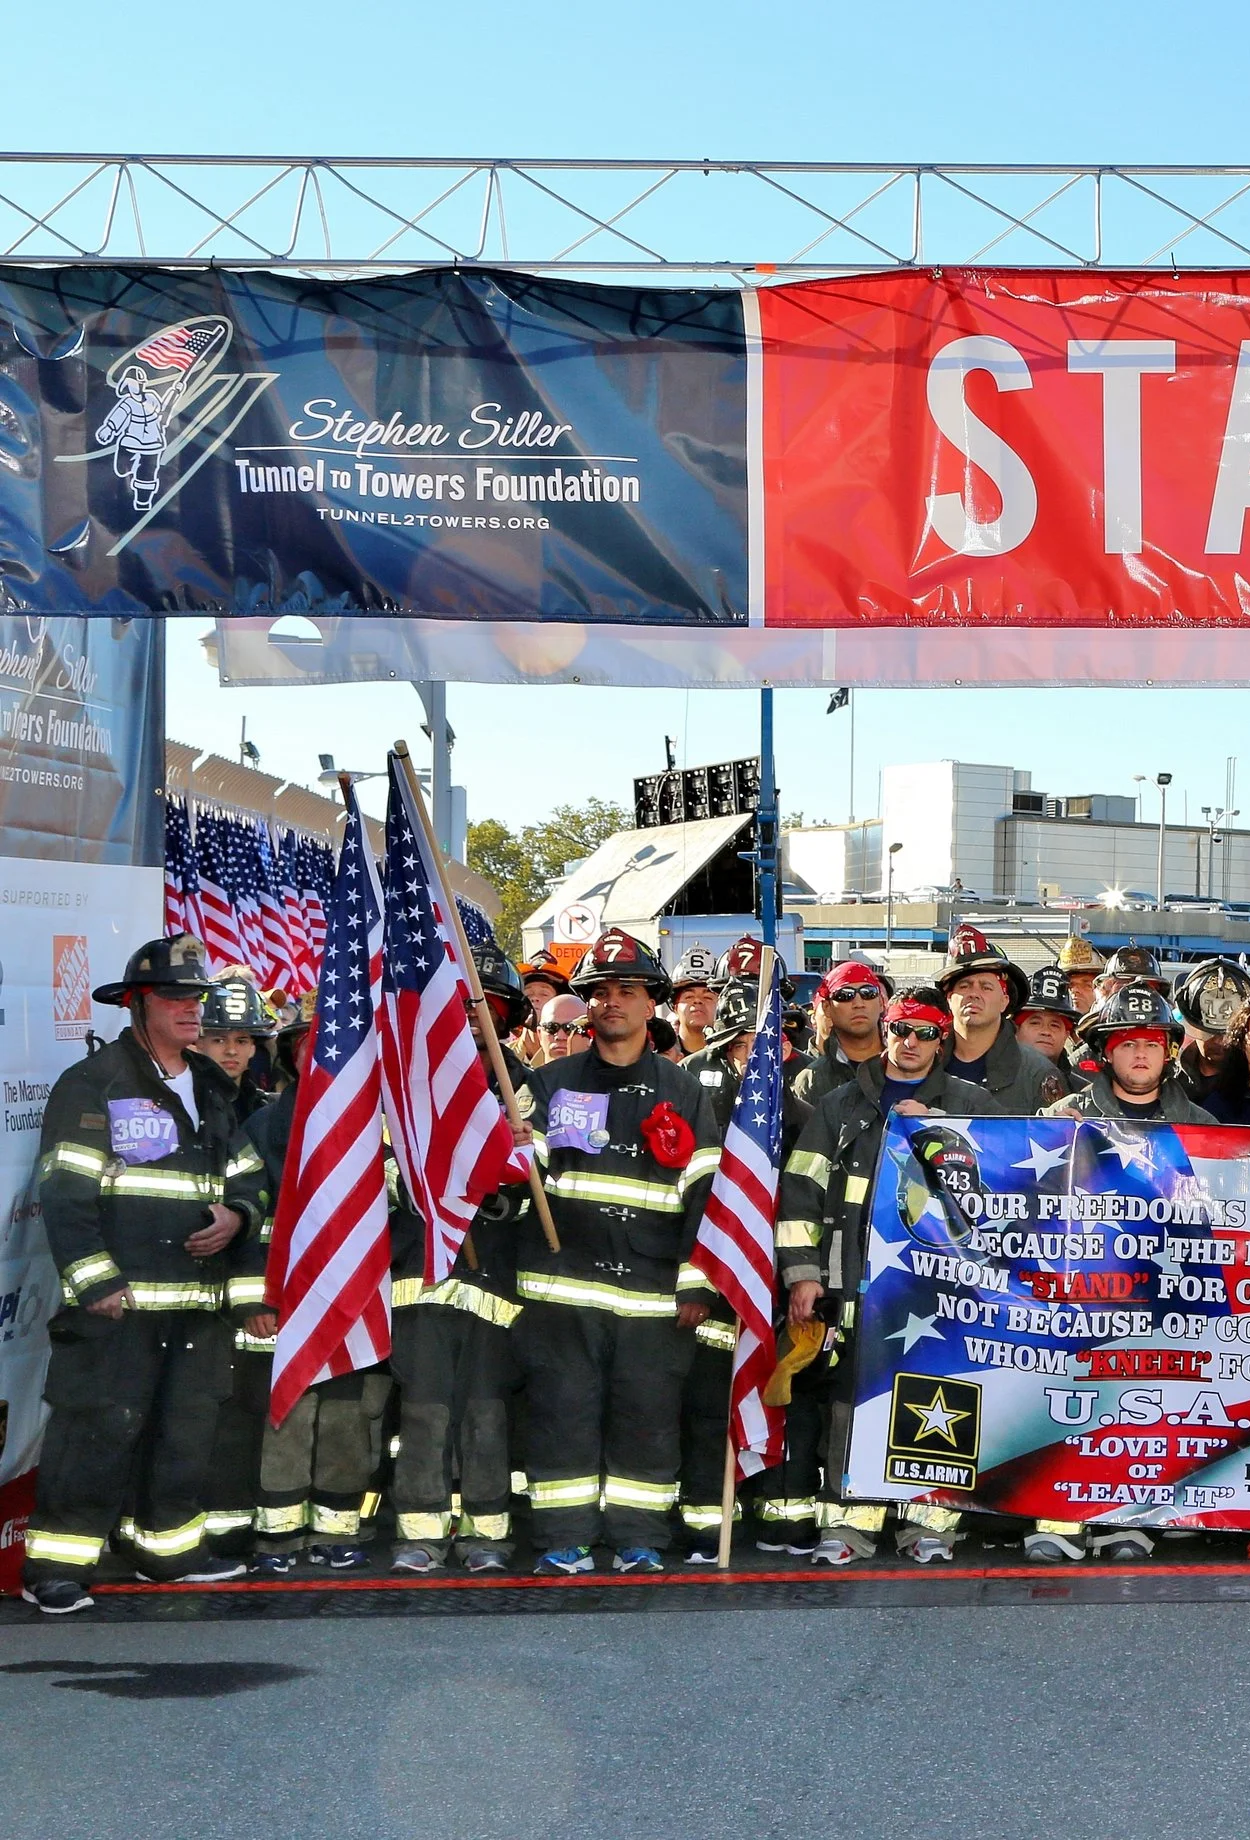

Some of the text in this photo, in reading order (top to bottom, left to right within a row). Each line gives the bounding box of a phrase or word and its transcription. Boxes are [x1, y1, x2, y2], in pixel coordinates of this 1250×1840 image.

[289, 398, 573, 459] Stephen Siller
[235, 458, 641, 503] Tunnel TO Towers Foundation
[316, 507, 551, 531] TUNNEL2TOWERS.ORG
[47, 709, 113, 755] Foundation
[3, 889, 89, 907] SUPPORTED BY
[556, 947, 587, 958] DETO
[603, 943, 623, 963] 7
[690, 954, 704, 968] 6
[738, 951, 754, 970] 7
[1042, 978, 1060, 998] 6
[728, 998, 749, 1018] 11
[1128, 997, 1152, 1012] 28
[3, 1080, 50, 1101] The Marcus
[5, 1110, 44, 1132] Foundati
[113, 1117, 174, 1142] 3607
[549, 1105, 601, 1131] 3651
[1037, 1193, 1203, 1226] FREEDOM
[1211, 1201, 1247, 1228] IS
[967, 1226, 1106, 1262] BECAUSE
[1113, 1233, 1159, 1262] OF
[1166, 1236, 1236, 1265] THE
[910, 1250, 1011, 1294] WHOM
[1157, 1273, 1227, 1304] FOR
[935, 1293, 1000, 1328] NOT
[1006, 1306, 1152, 1339] BECAUSE
[1162, 1311, 1207, 1340] OF
[964, 1336, 1068, 1377] WHOM
[1064, 1436, 1229, 1460] “LOVE IT”
[1127, 1463, 1164, 1480] or
[1053, 1481, 1236, 1509] “LEAVE IT”
